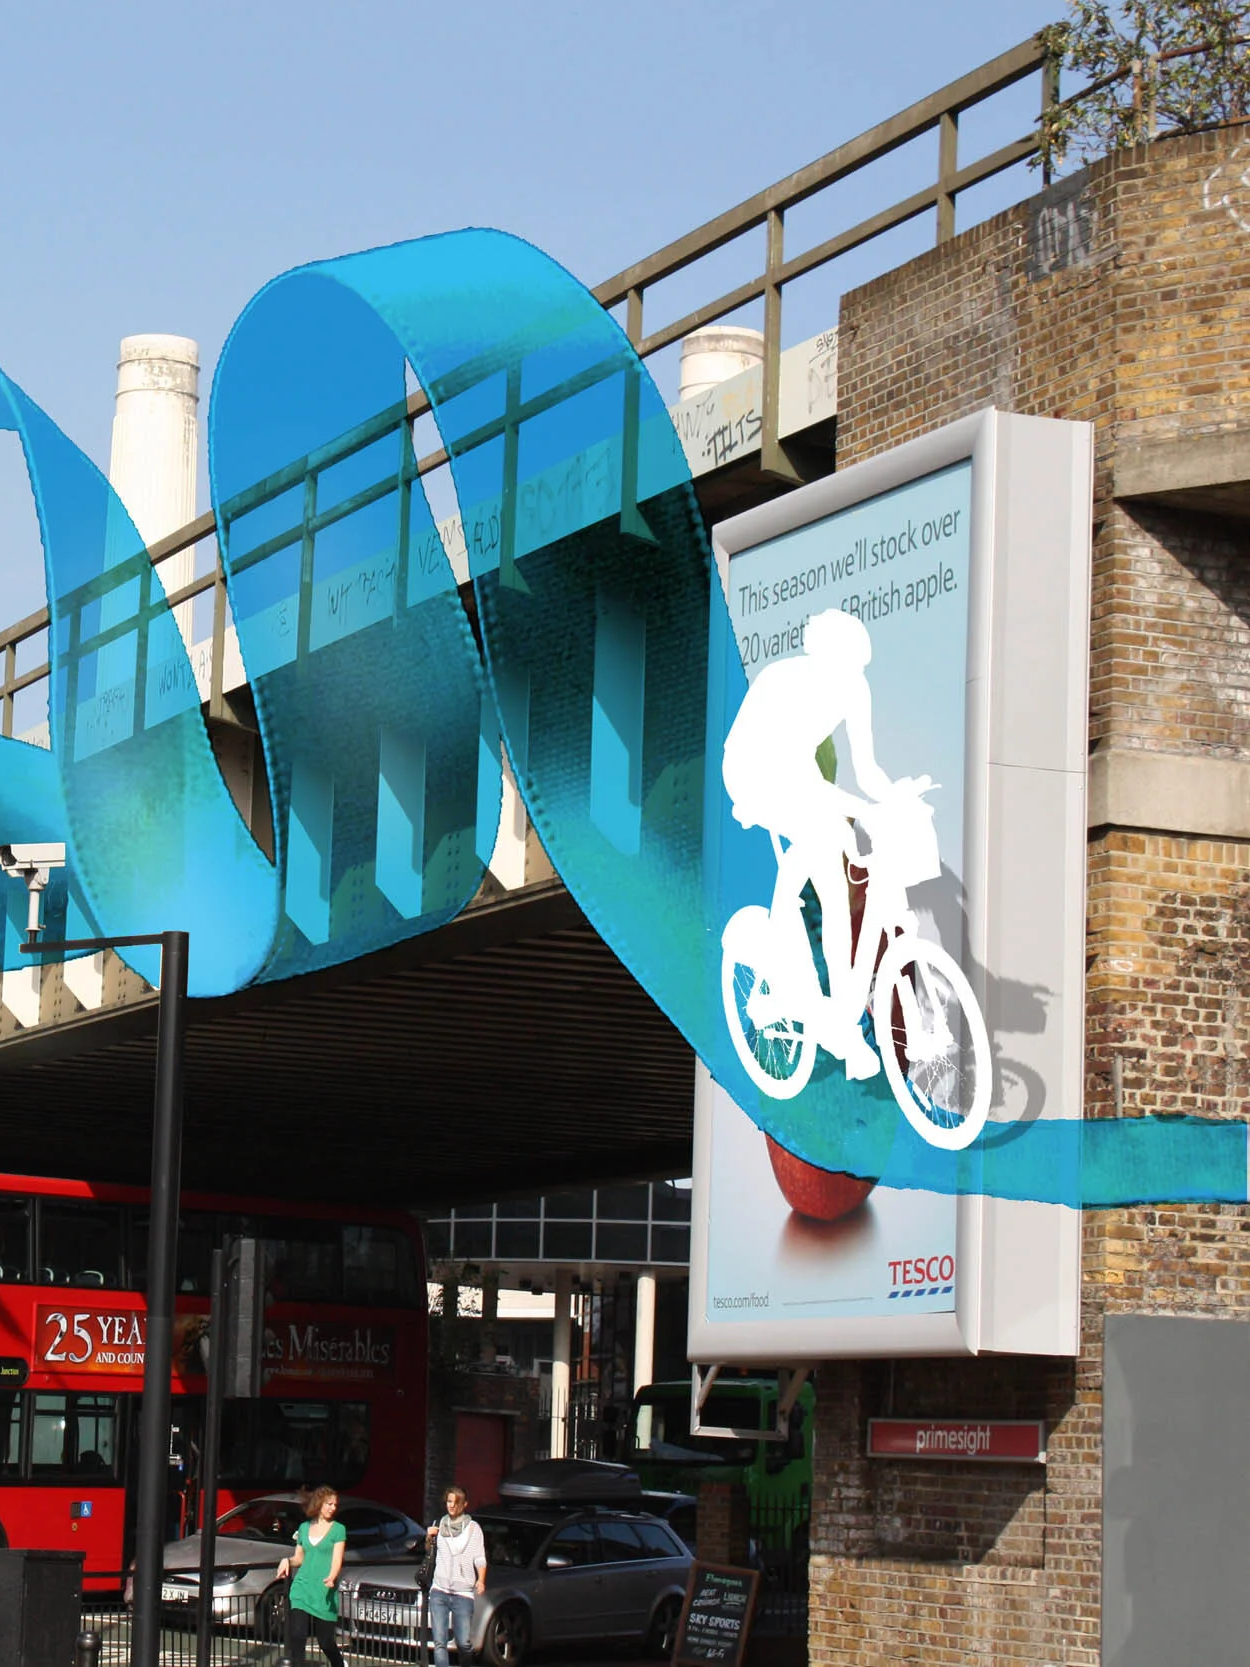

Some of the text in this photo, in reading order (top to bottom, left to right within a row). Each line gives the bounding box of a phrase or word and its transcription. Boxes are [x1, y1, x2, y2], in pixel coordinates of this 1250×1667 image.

[739, 509, 961, 617] This season we'll stock over
[741, 631, 760, 667] 20
[762, 614, 810, 660] variet
[849, 580, 901, 624] British
[905, 561, 958, 613] apple.
[888, 1254, 955, 1286] TESCO
[713, 1291, 770, 1310] tesco.com/food
[44, 1312, 147, 1364] 25 YEA
[261, 1324, 391, 1365] es Misérables
[0, 1367, 19, 1376] Junction
[95, 1352, 145, 1365] AND COUN
[915, 1424, 991, 1455] primesight
[689, 1612, 741, 1631] SKY SPORTS
